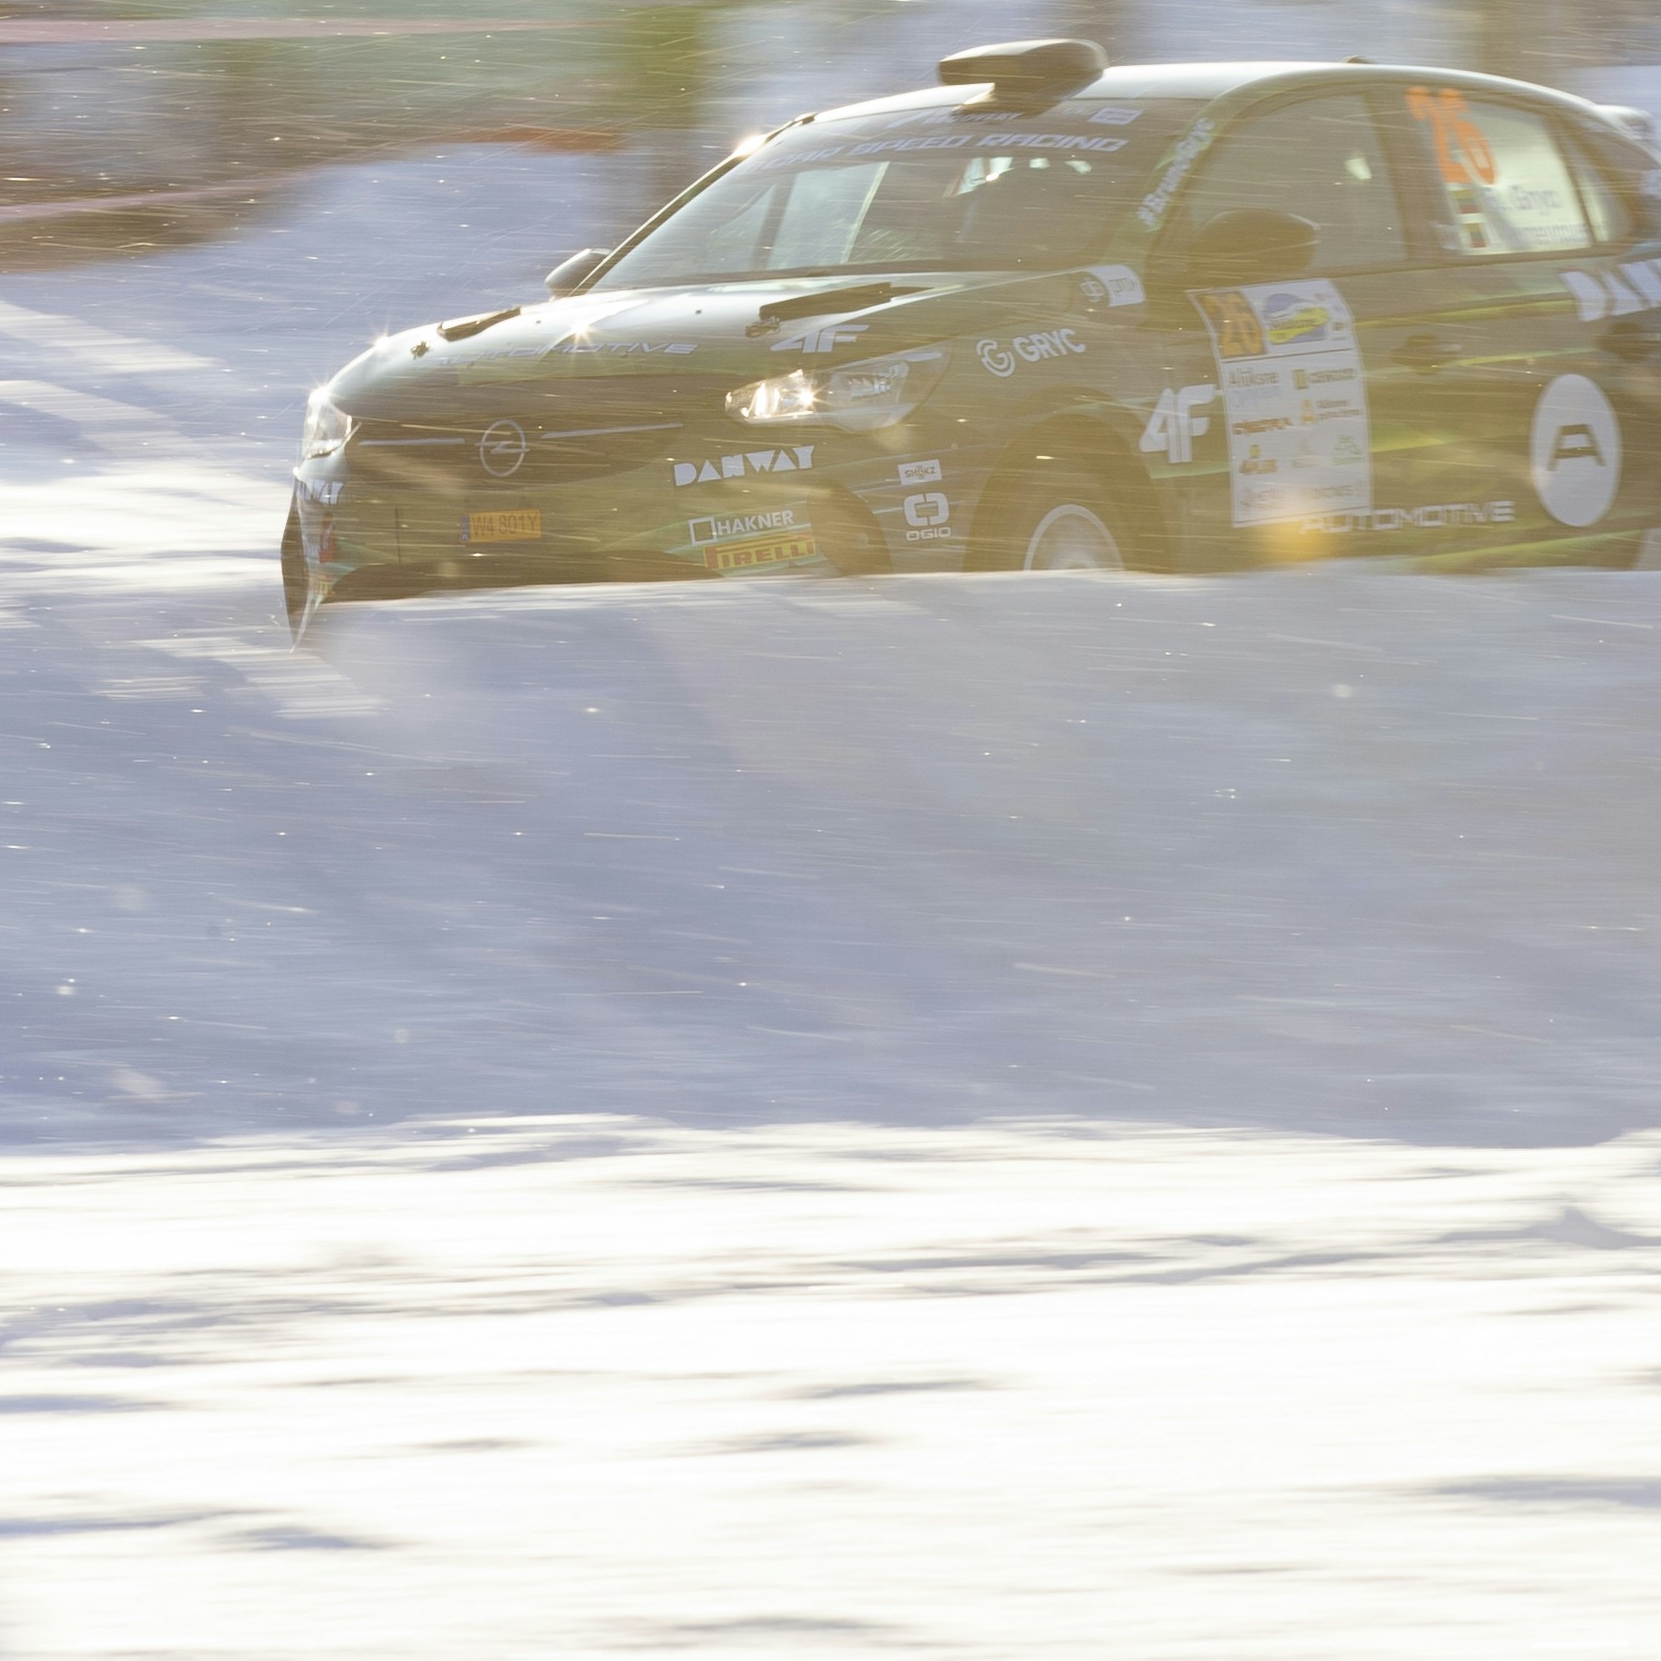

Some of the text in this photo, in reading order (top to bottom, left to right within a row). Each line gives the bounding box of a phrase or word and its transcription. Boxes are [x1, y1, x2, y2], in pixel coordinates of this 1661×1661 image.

[847, 134, 975, 157] SPEED
[976, 133, 1130, 153] RACING
[1404, 86, 1496, 184] 26
[770, 324, 870, 354] 4F
[1013, 328, 1087, 362] GRYC
[1138, 384, 1216, 464] 4F
[673, 444, 816, 487] DANWAY
[717, 509, 795, 536] HAKNER
[905, 526, 952, 542] OGIO
[1300, 500, 1516, 534] AUTOMOTIVE
[705, 531, 816, 570] PIRELLI
